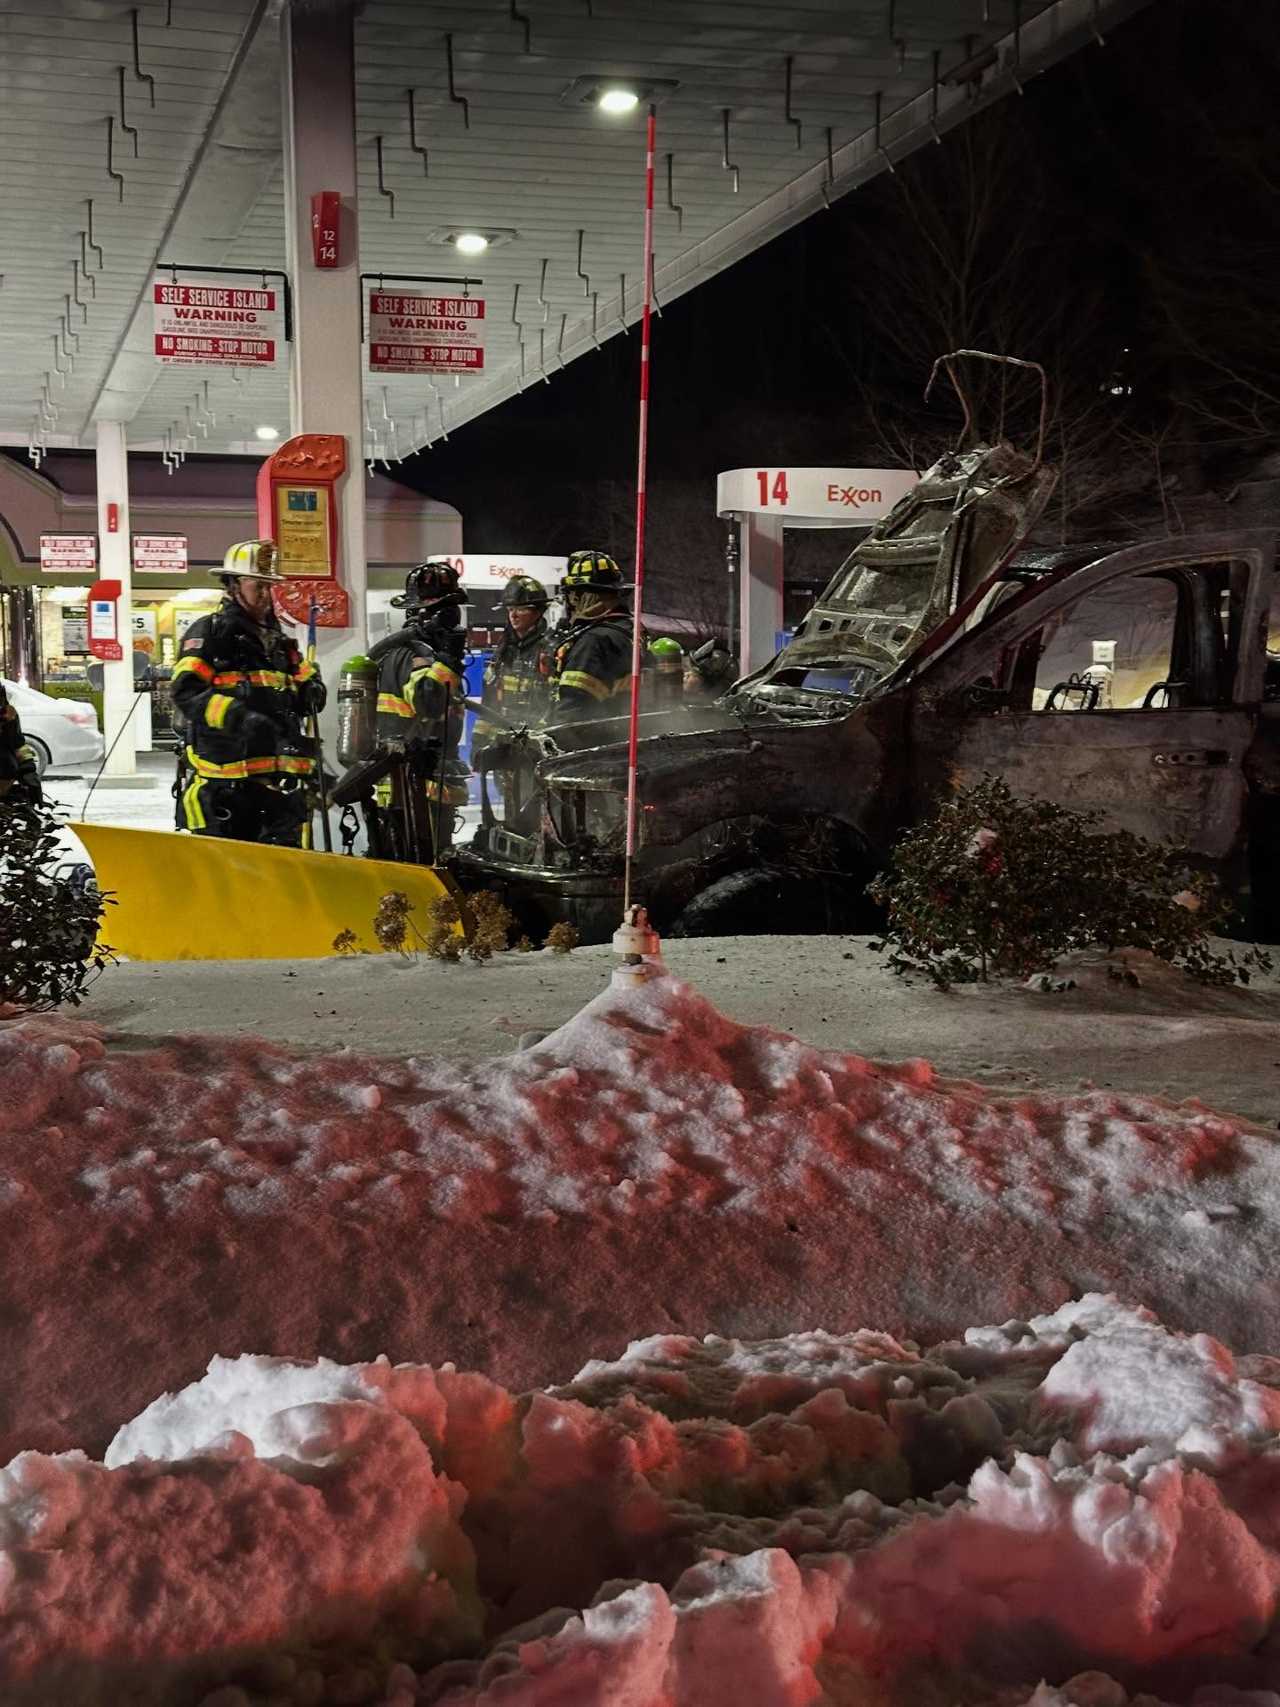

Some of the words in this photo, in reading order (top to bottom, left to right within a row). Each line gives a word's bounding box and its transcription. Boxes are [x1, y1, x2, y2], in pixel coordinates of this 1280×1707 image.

[322, 230, 335, 241] 12
[320, 246, 336, 260] 14
[161, 287, 185, 303] SELF
[189, 289, 230, 306] SERVICE
[233, 291, 268, 309] ISLAND
[377, 297, 400, 313] SELF
[402, 299, 442, 315] SERVICE
[445, 300, 479, 317] ISLAND
[174, 308, 257, 323] WARNING
[388, 317, 467, 331] WARNING
[161, 336, 174, 349] NO
[176, 337, 213, 352] SMOKING
[218, 340, 239, 353] STOP
[240, 341, 269, 355] MOTOR
[377, 346, 389, 358] NO
[390, 347, 425, 360] SMOKING
[430, 348, 450, 361] STOP
[451, 349, 477, 362] MOTOR
[756, 470, 789, 507] 14
[827, 484, 881, 508] Exxon
[489, 565, 525, 579] Exxon
